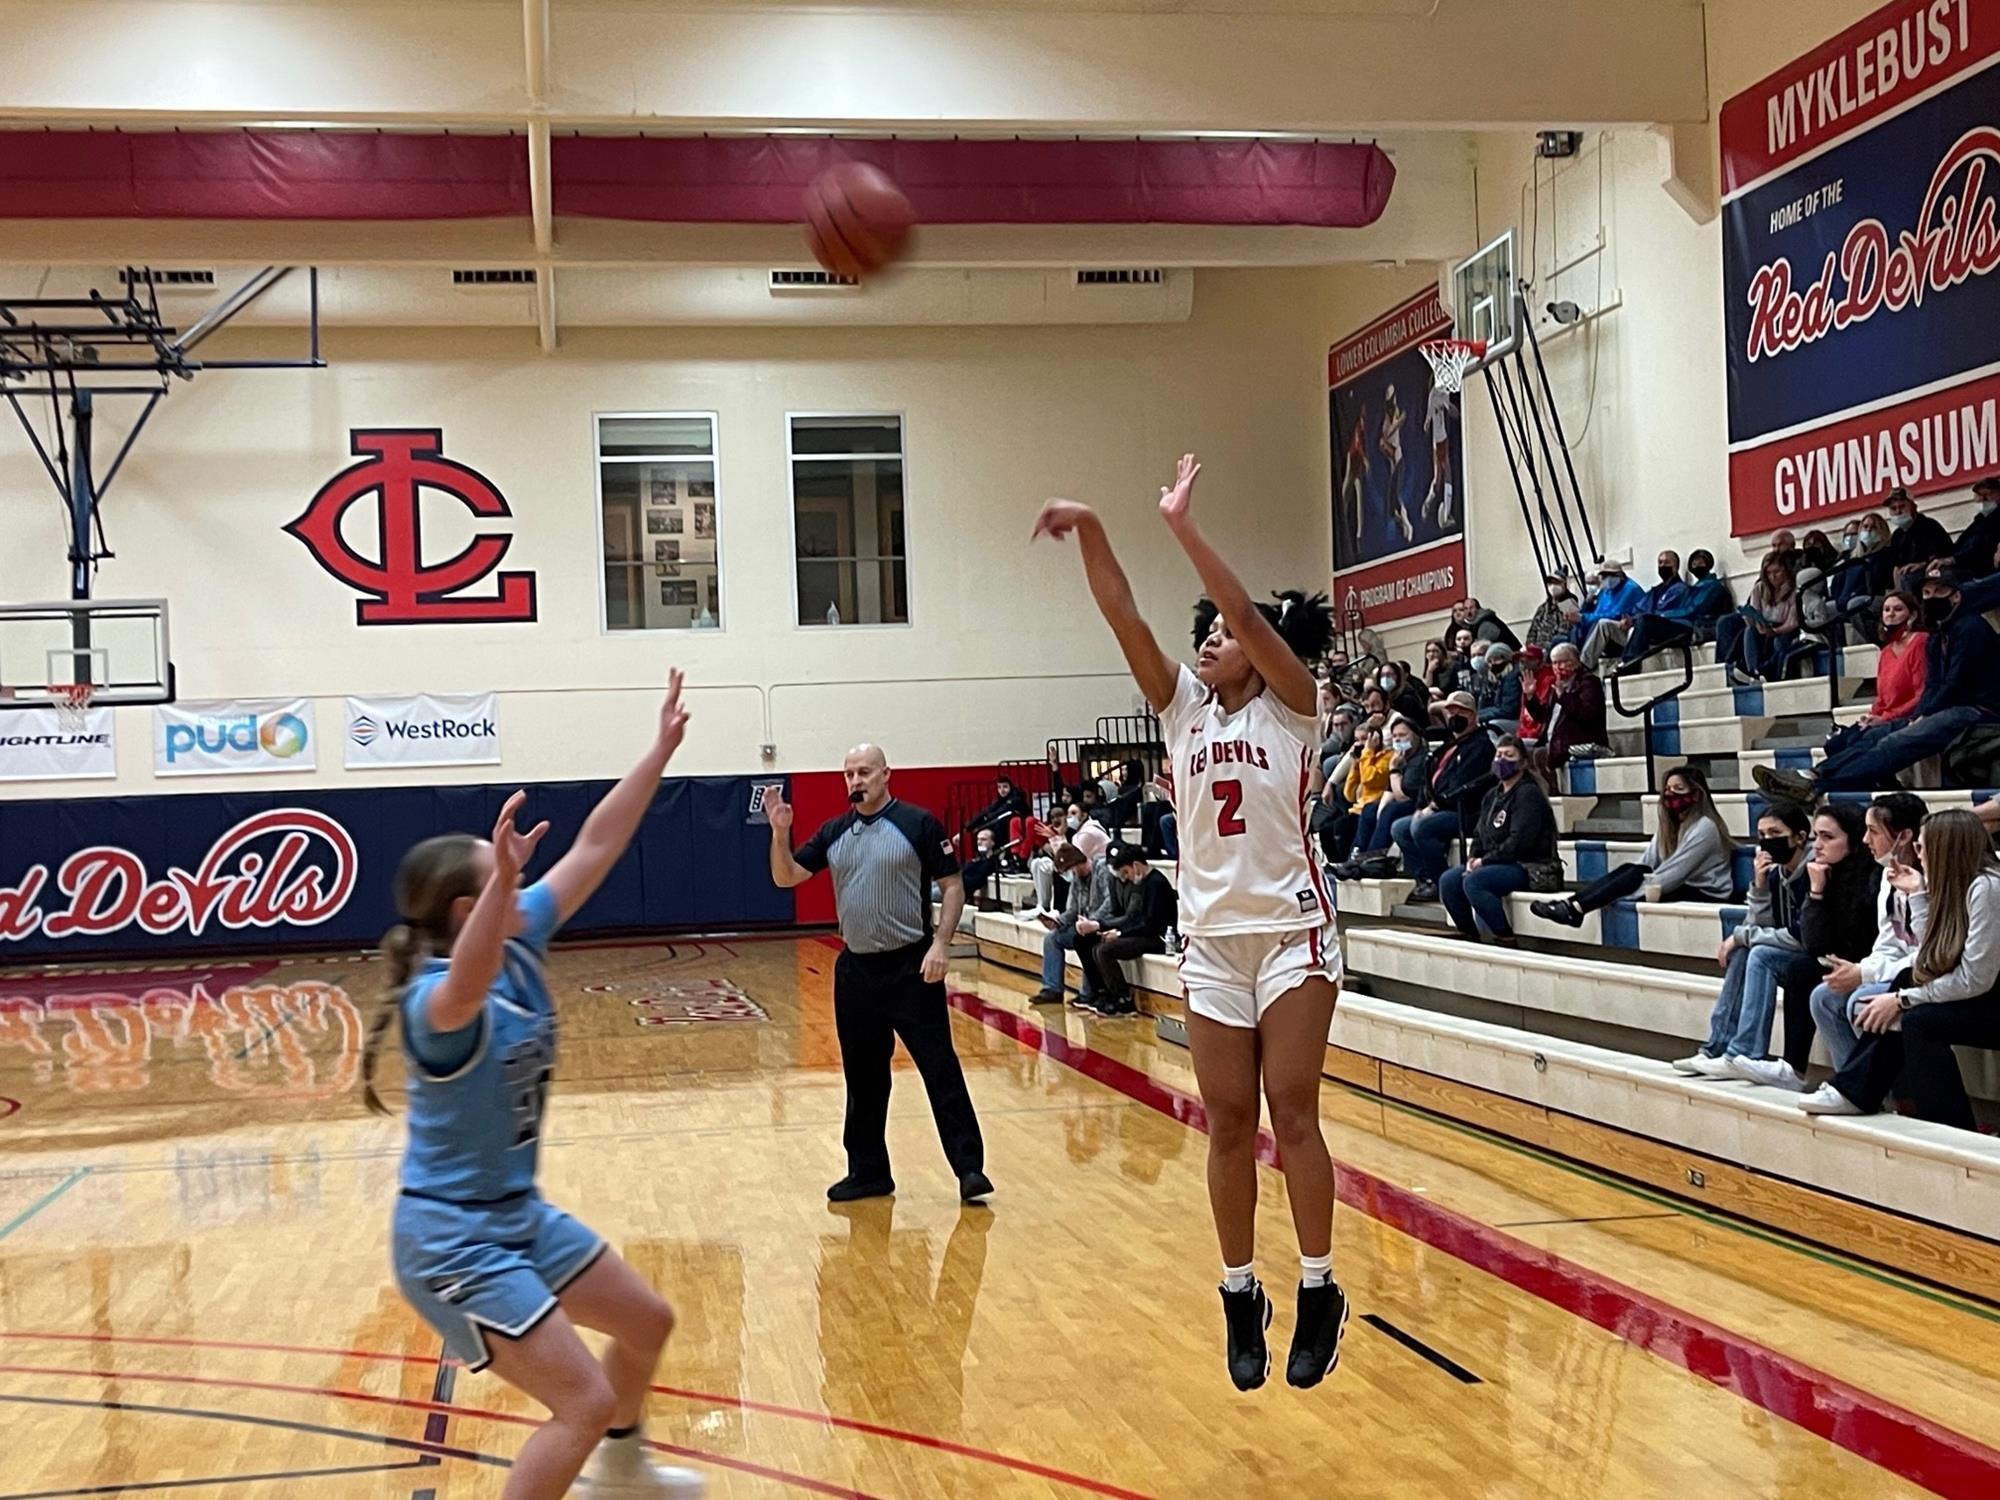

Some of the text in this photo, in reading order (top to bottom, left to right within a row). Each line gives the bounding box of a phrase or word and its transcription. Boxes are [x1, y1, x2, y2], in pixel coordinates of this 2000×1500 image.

[1767, 0, 1969, 154] MYKLEBUST
[1770, 178, 1843, 234] HOME OF THE
[1747, 126, 2000, 363] Red Devils
[1337, 342, 1365, 377] LOWER
[1364, 319, 1408, 362] COLUMBIA
[1775, 398, 1998, 516] GYMNASIUM
[1360, 582, 1395, 609] PROGRAM
[1395, 579, 1406, 600] OF
[1407, 565, 1454, 598] CHAMPIONS
[385, 718, 496, 740] WestRock
[1211, 779, 1247, 838] 2
[42, 807, 359, 936] Devils
